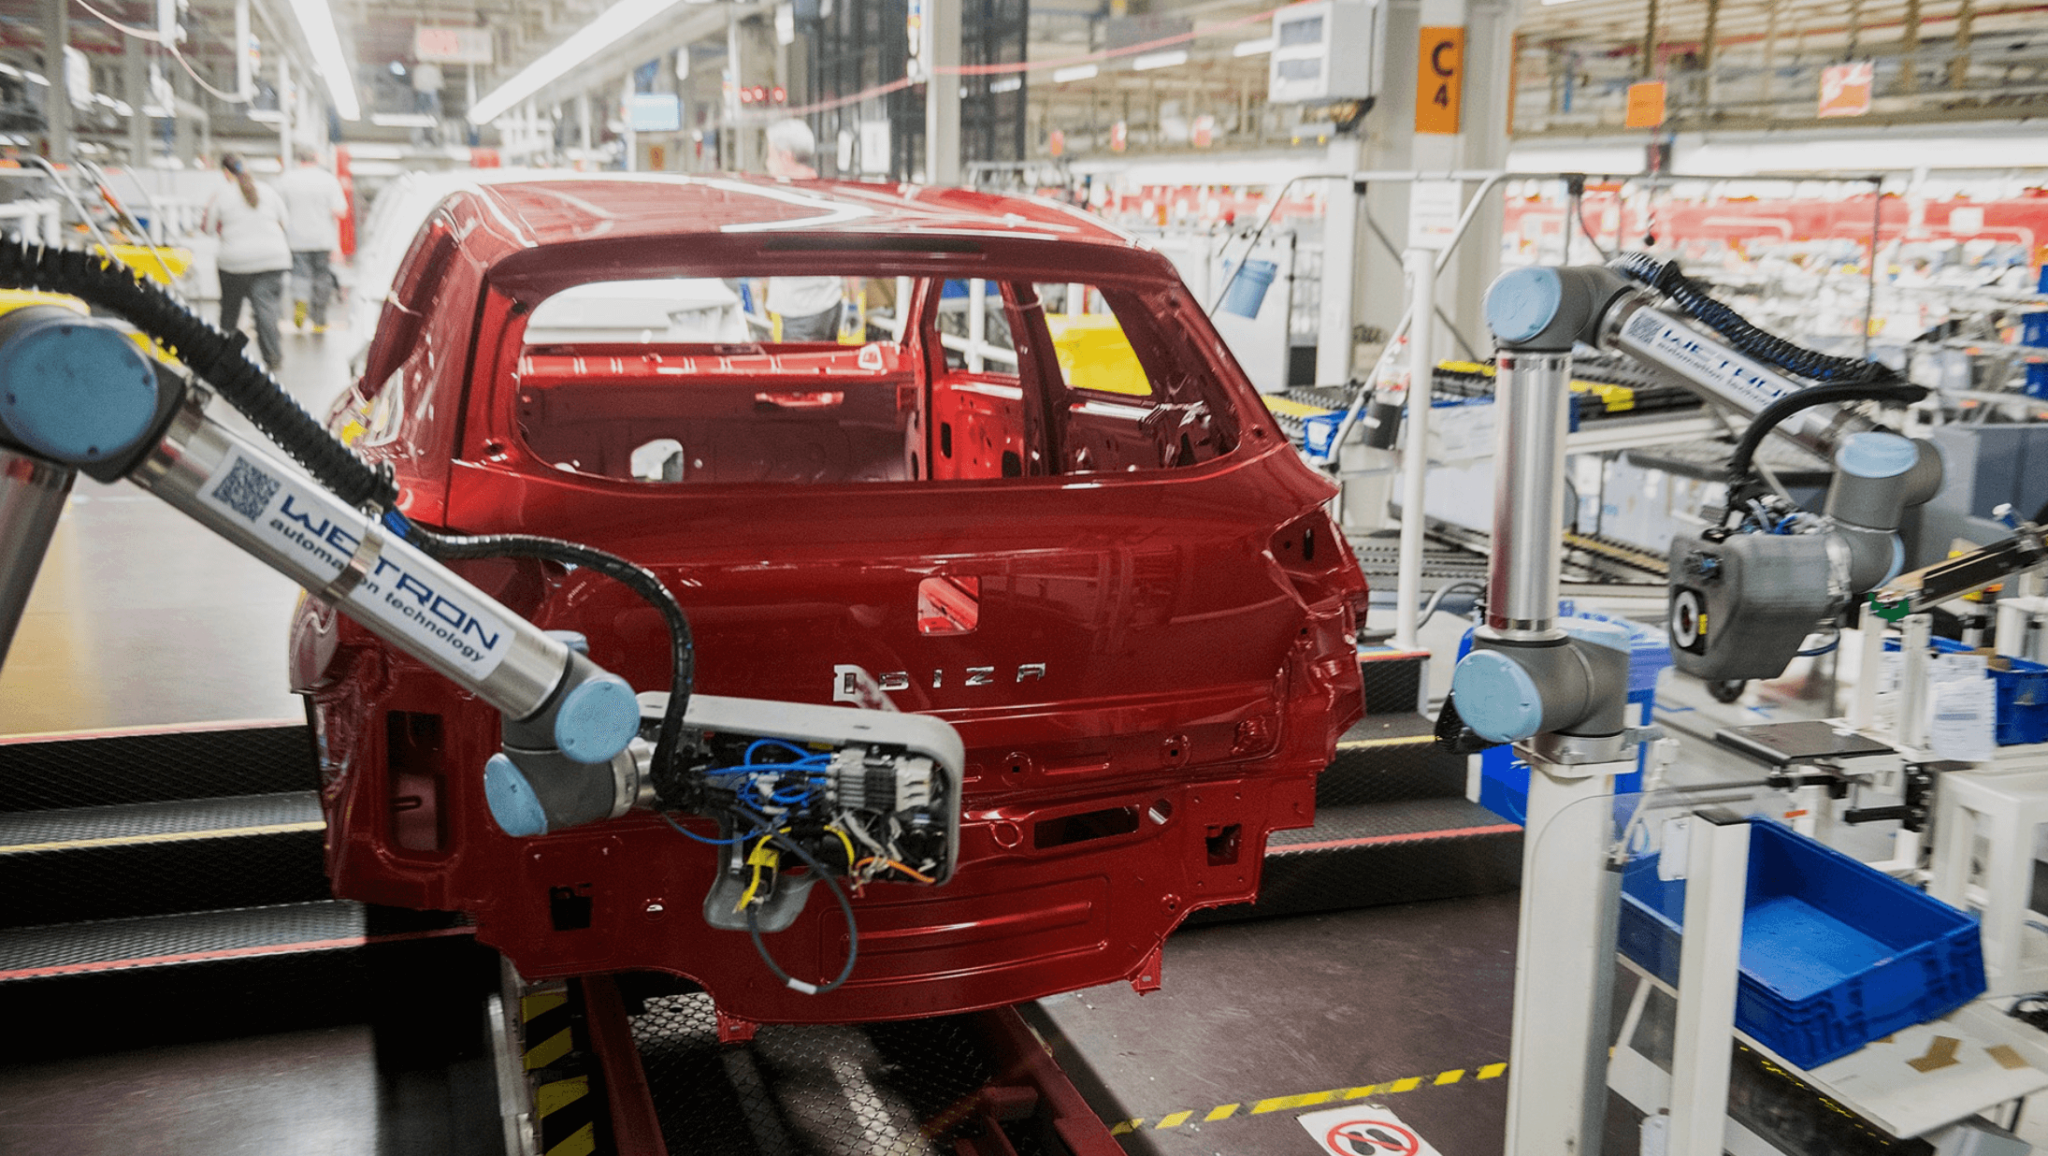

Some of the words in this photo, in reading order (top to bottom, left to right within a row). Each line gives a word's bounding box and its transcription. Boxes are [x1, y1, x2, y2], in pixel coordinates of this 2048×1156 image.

[1431, 41, 1454, 77] C
[1434, 83, 1448, 108] 4
[269, 517, 380, 595] automaon
[384, 591, 486, 663] technology
